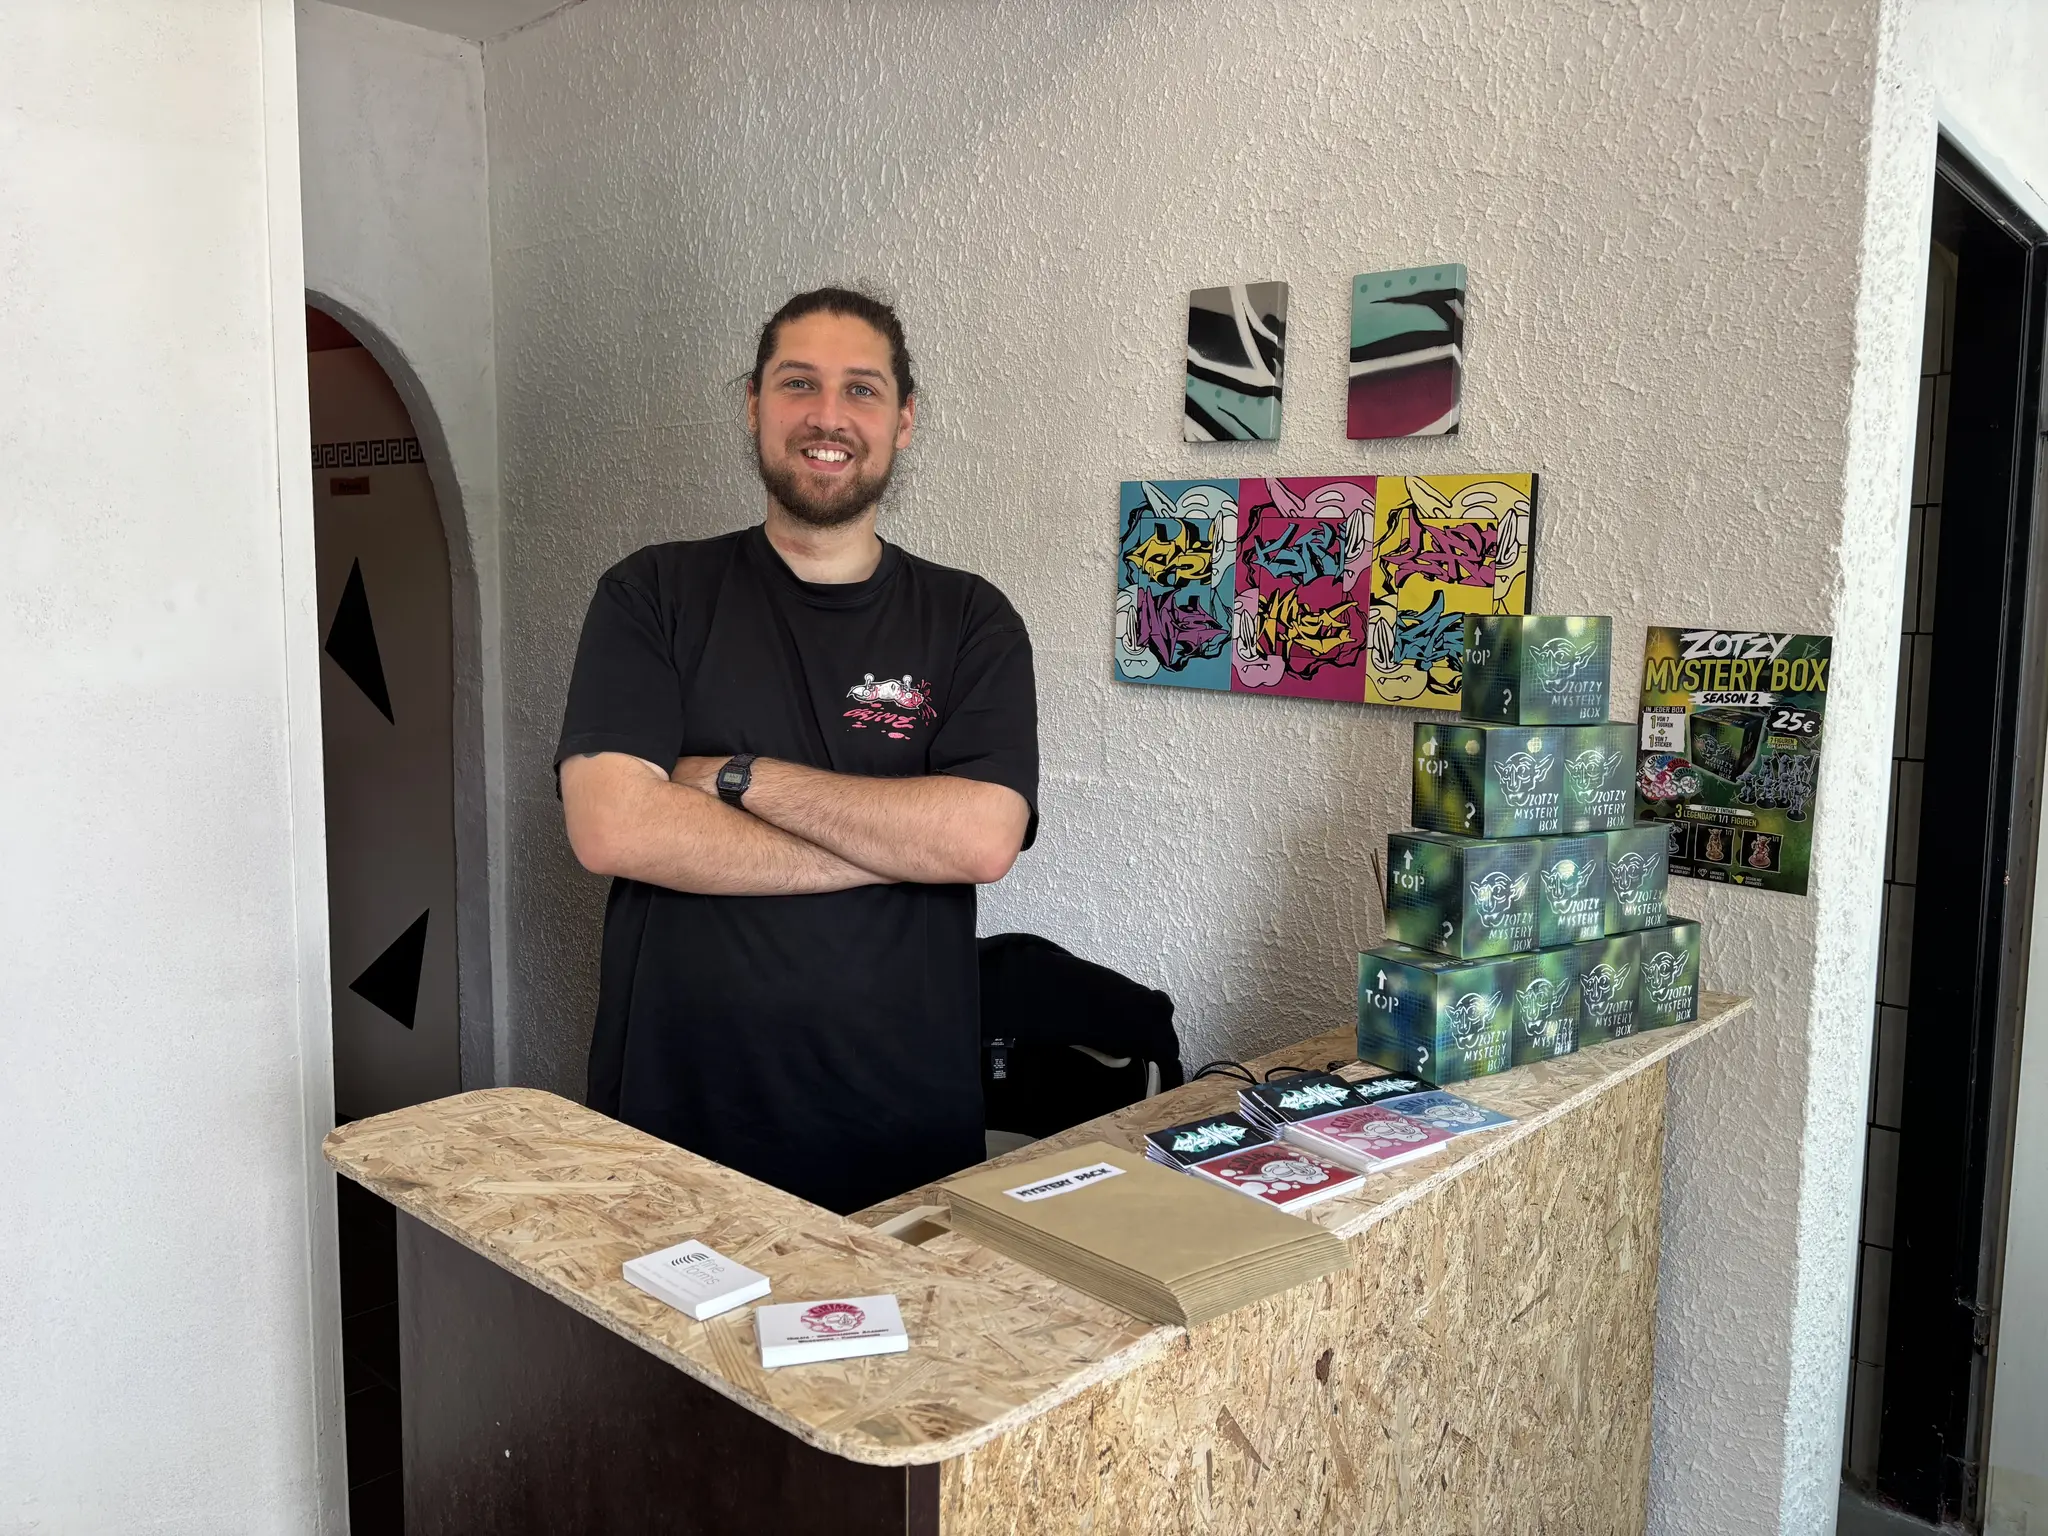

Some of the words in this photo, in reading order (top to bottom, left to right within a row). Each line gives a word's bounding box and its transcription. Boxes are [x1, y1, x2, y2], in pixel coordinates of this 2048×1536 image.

[1680, 630, 1794, 664] ZOTZY
[1465, 648, 1491, 666] TOP
[1645, 658, 1766, 692] MYSTERY
[1770, 658, 1829, 692] BOX
[1568, 681, 1603, 693] ZOTZY
[1502, 688, 1513, 714] ?
[1551, 694, 1602, 707] MYSTERY
[1702, 692, 1748, 704] SEASON
[1749, 693, 1760, 704] 2
[1580, 707, 1601, 719] BOX
[1650, 715, 1657, 729] 1
[1771, 710, 1816, 733] 25€
[1648, 734, 1655, 748] 1
[1417, 757, 1448, 777] TOP
[1529, 792, 1559, 806] ZOTZY
[1597, 790, 1627, 803] ZOTZY
[1464, 802, 1476, 828] ?
[1514, 806, 1559, 820] MYSTERY
[1584, 802, 1626, 816] MYSTERY
[1675, 803, 1682, 818] 3
[1683, 810, 1717, 822] LEGENDARY
[1718, 814, 1729, 824] 1/1
[1730, 816, 1758, 828] FIGUREN
[1539, 819, 1558, 832] BOX
[1606, 815, 1626, 828] BOX
[1393, 870, 1425, 892] TOP
[1637, 889, 1663, 903] ZOTZY
[1572, 898, 1600, 913] ZOTZY
[1624, 901, 1663, 916] MYSTERY
[1504, 912, 1533, 926] ZOTZY
[1557, 911, 1600, 926] MYSTERY
[1645, 914, 1662, 927] BOX
[1442, 921, 1454, 948] ?
[1488, 925, 1533, 940] MYSTERY
[1512, 938, 1532, 952] BOX
[1668, 985, 1693, 1000] ZOTZY
[1365, 988, 1399, 1013] TOP
[1608, 1000, 1634, 1014] ZOTZY
[1656, 997, 1693, 1013] MYSTERY
[1594, 1012, 1633, 1027] MYSTERY
[1675, 1009, 1691, 1022] BOX
[1615, 1024, 1632, 1037] BOX
[1478, 1030, 1507, 1047] ZOTZY
[1416, 1046, 1430, 1073] ?
[1464, 1043, 1507, 1062] MYSTERY
[1487, 1056, 1506, 1071] BOX
[1016, 1178, 1074, 1197] MYSTERY
[1074, 1167, 1112, 1182] PACK
[700, 1259, 725, 1274] fine
[683, 1265, 720, 1285] forms
